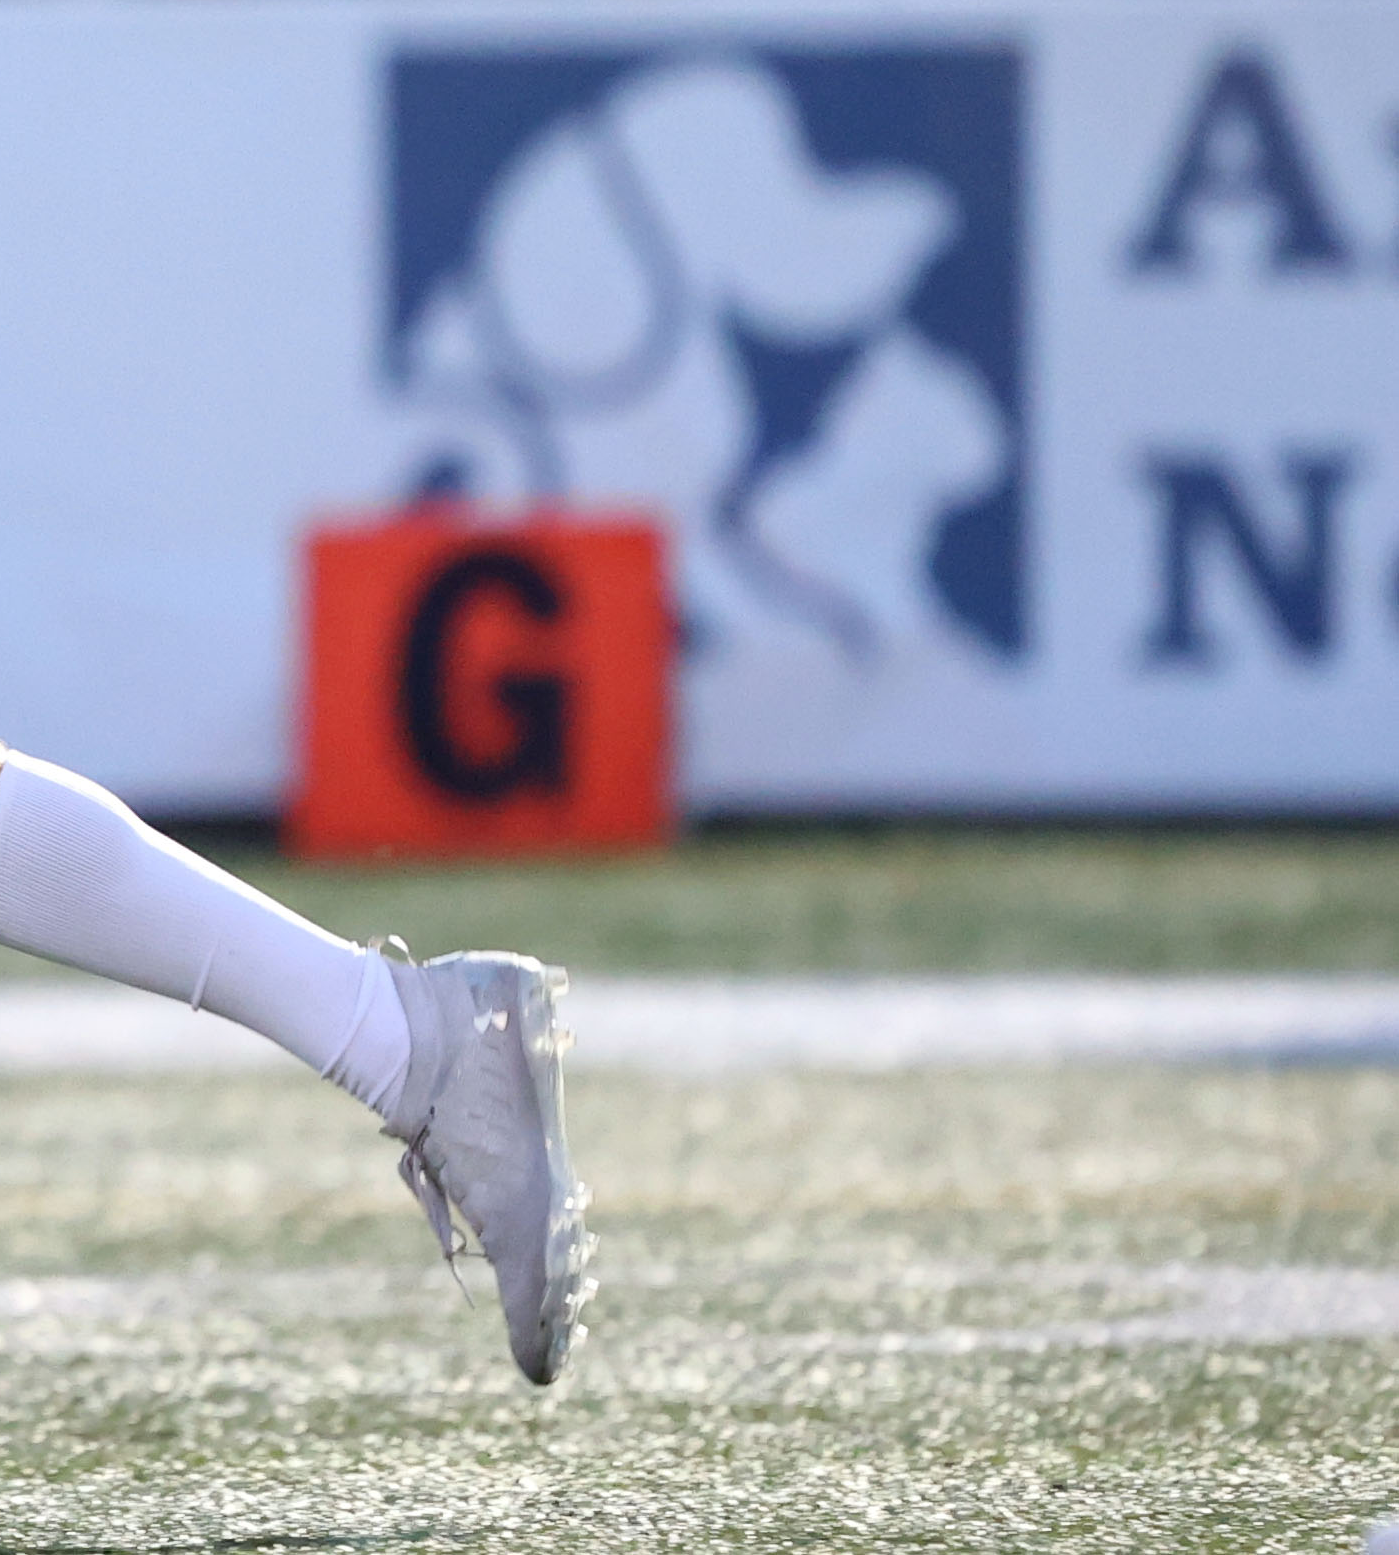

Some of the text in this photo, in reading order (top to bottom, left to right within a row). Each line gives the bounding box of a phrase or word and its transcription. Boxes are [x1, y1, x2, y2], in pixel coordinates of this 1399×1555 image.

[1118, 43, 1399, 283] A
[397, 545, 571, 805] G
[1135, 448, 1399, 671] N
